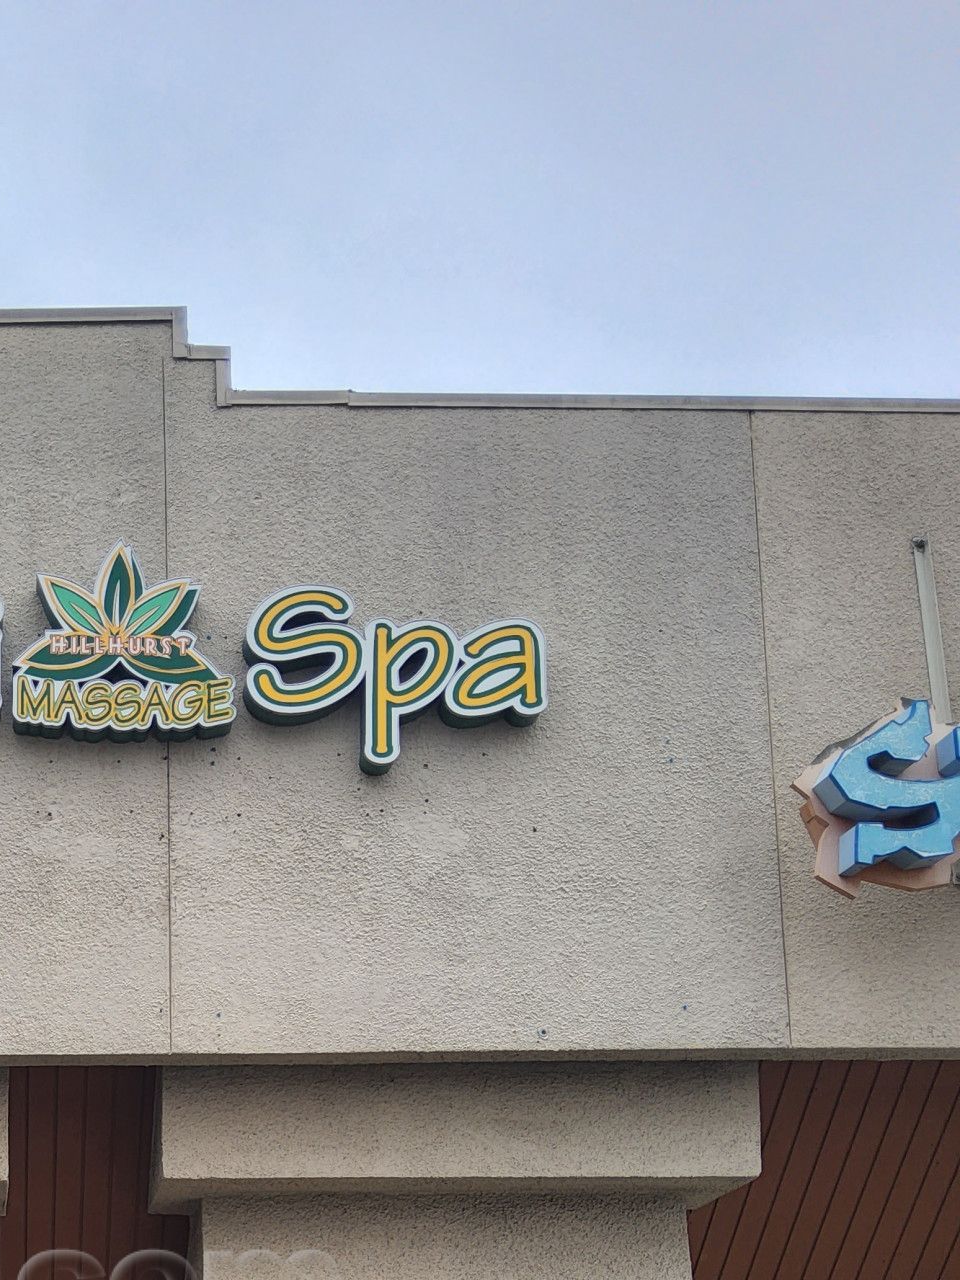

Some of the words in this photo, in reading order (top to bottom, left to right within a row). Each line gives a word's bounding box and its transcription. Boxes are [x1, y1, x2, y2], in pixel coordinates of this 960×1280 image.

[50, 635, 192, 659] HILLHURST
[17, 675, 234, 729] MASSAGE
[248, 585, 547, 766] Spa
